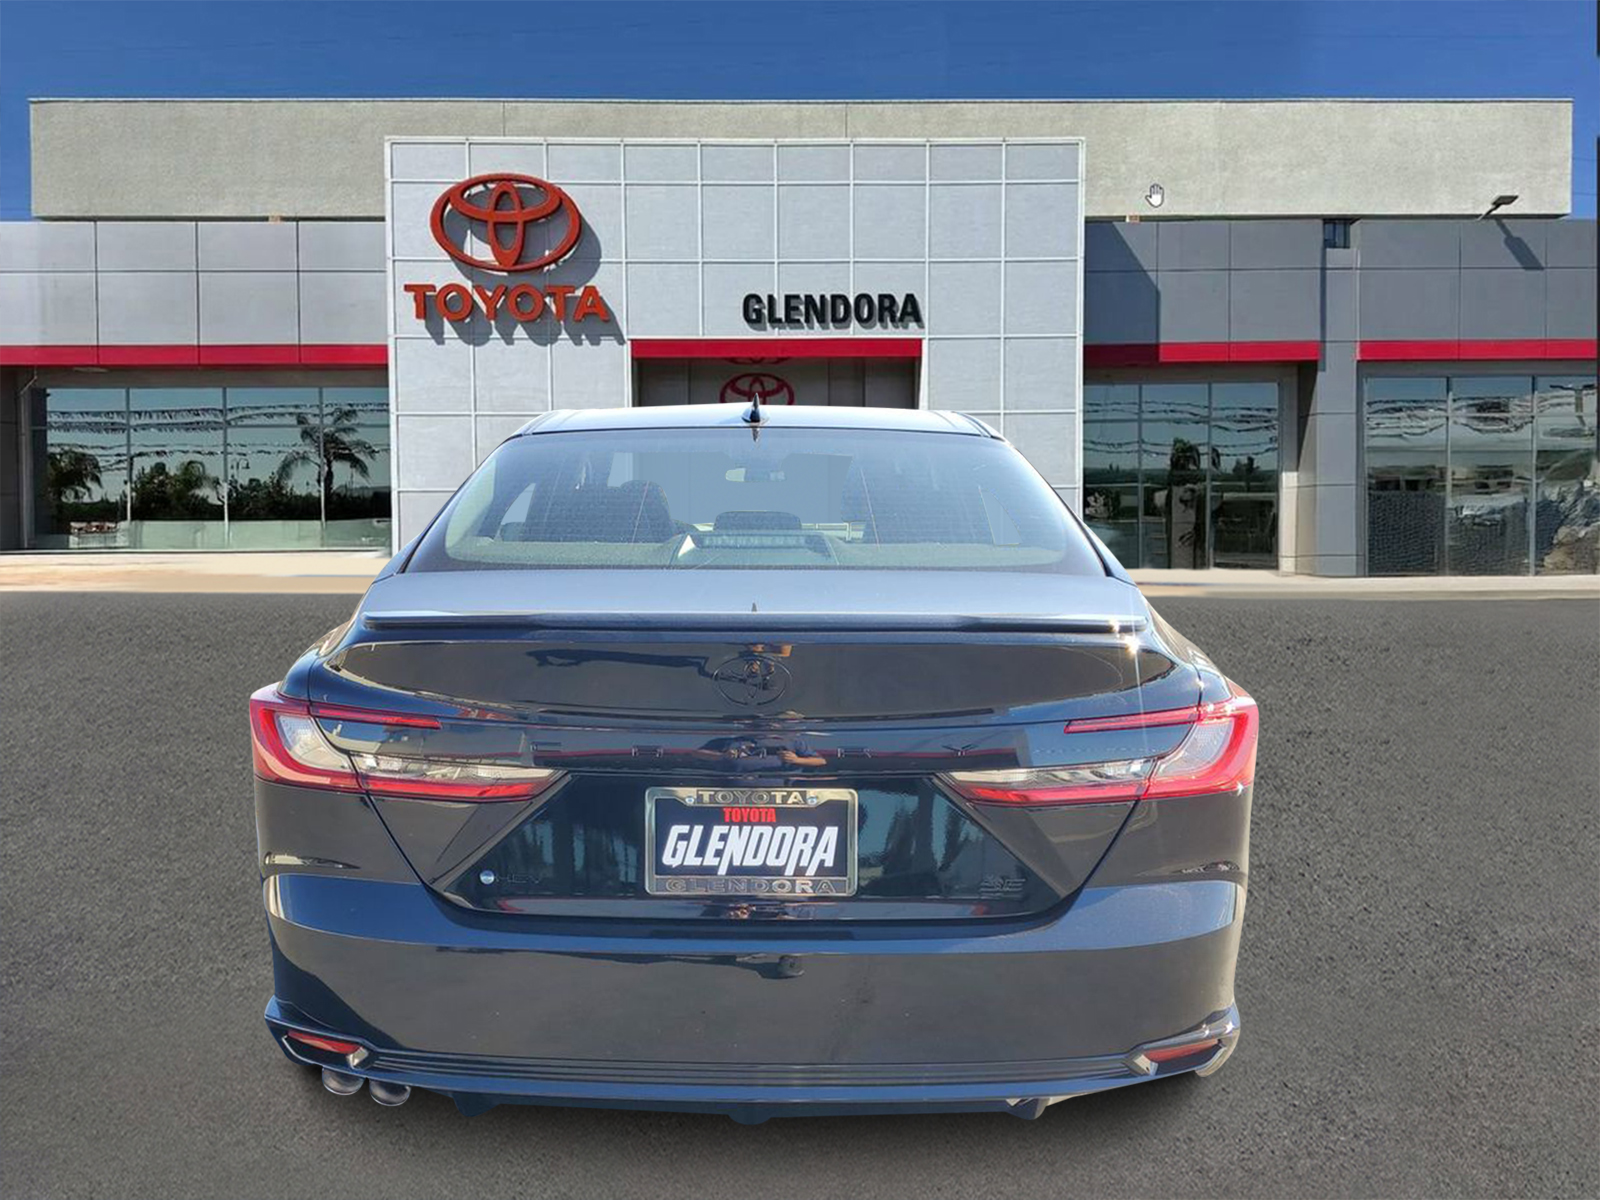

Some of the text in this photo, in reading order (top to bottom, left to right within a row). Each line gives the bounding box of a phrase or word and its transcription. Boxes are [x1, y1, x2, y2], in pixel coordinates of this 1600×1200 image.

[404, 284, 609, 322] TOYOTA
[743, 293, 922, 325] GLENDORA
[698, 790, 804, 804] TOYOTA
[723, 807, 777, 823] TOYOTA
[662, 825, 839, 876] GLENDORA
[665, 879, 837, 894] GLENDORA
